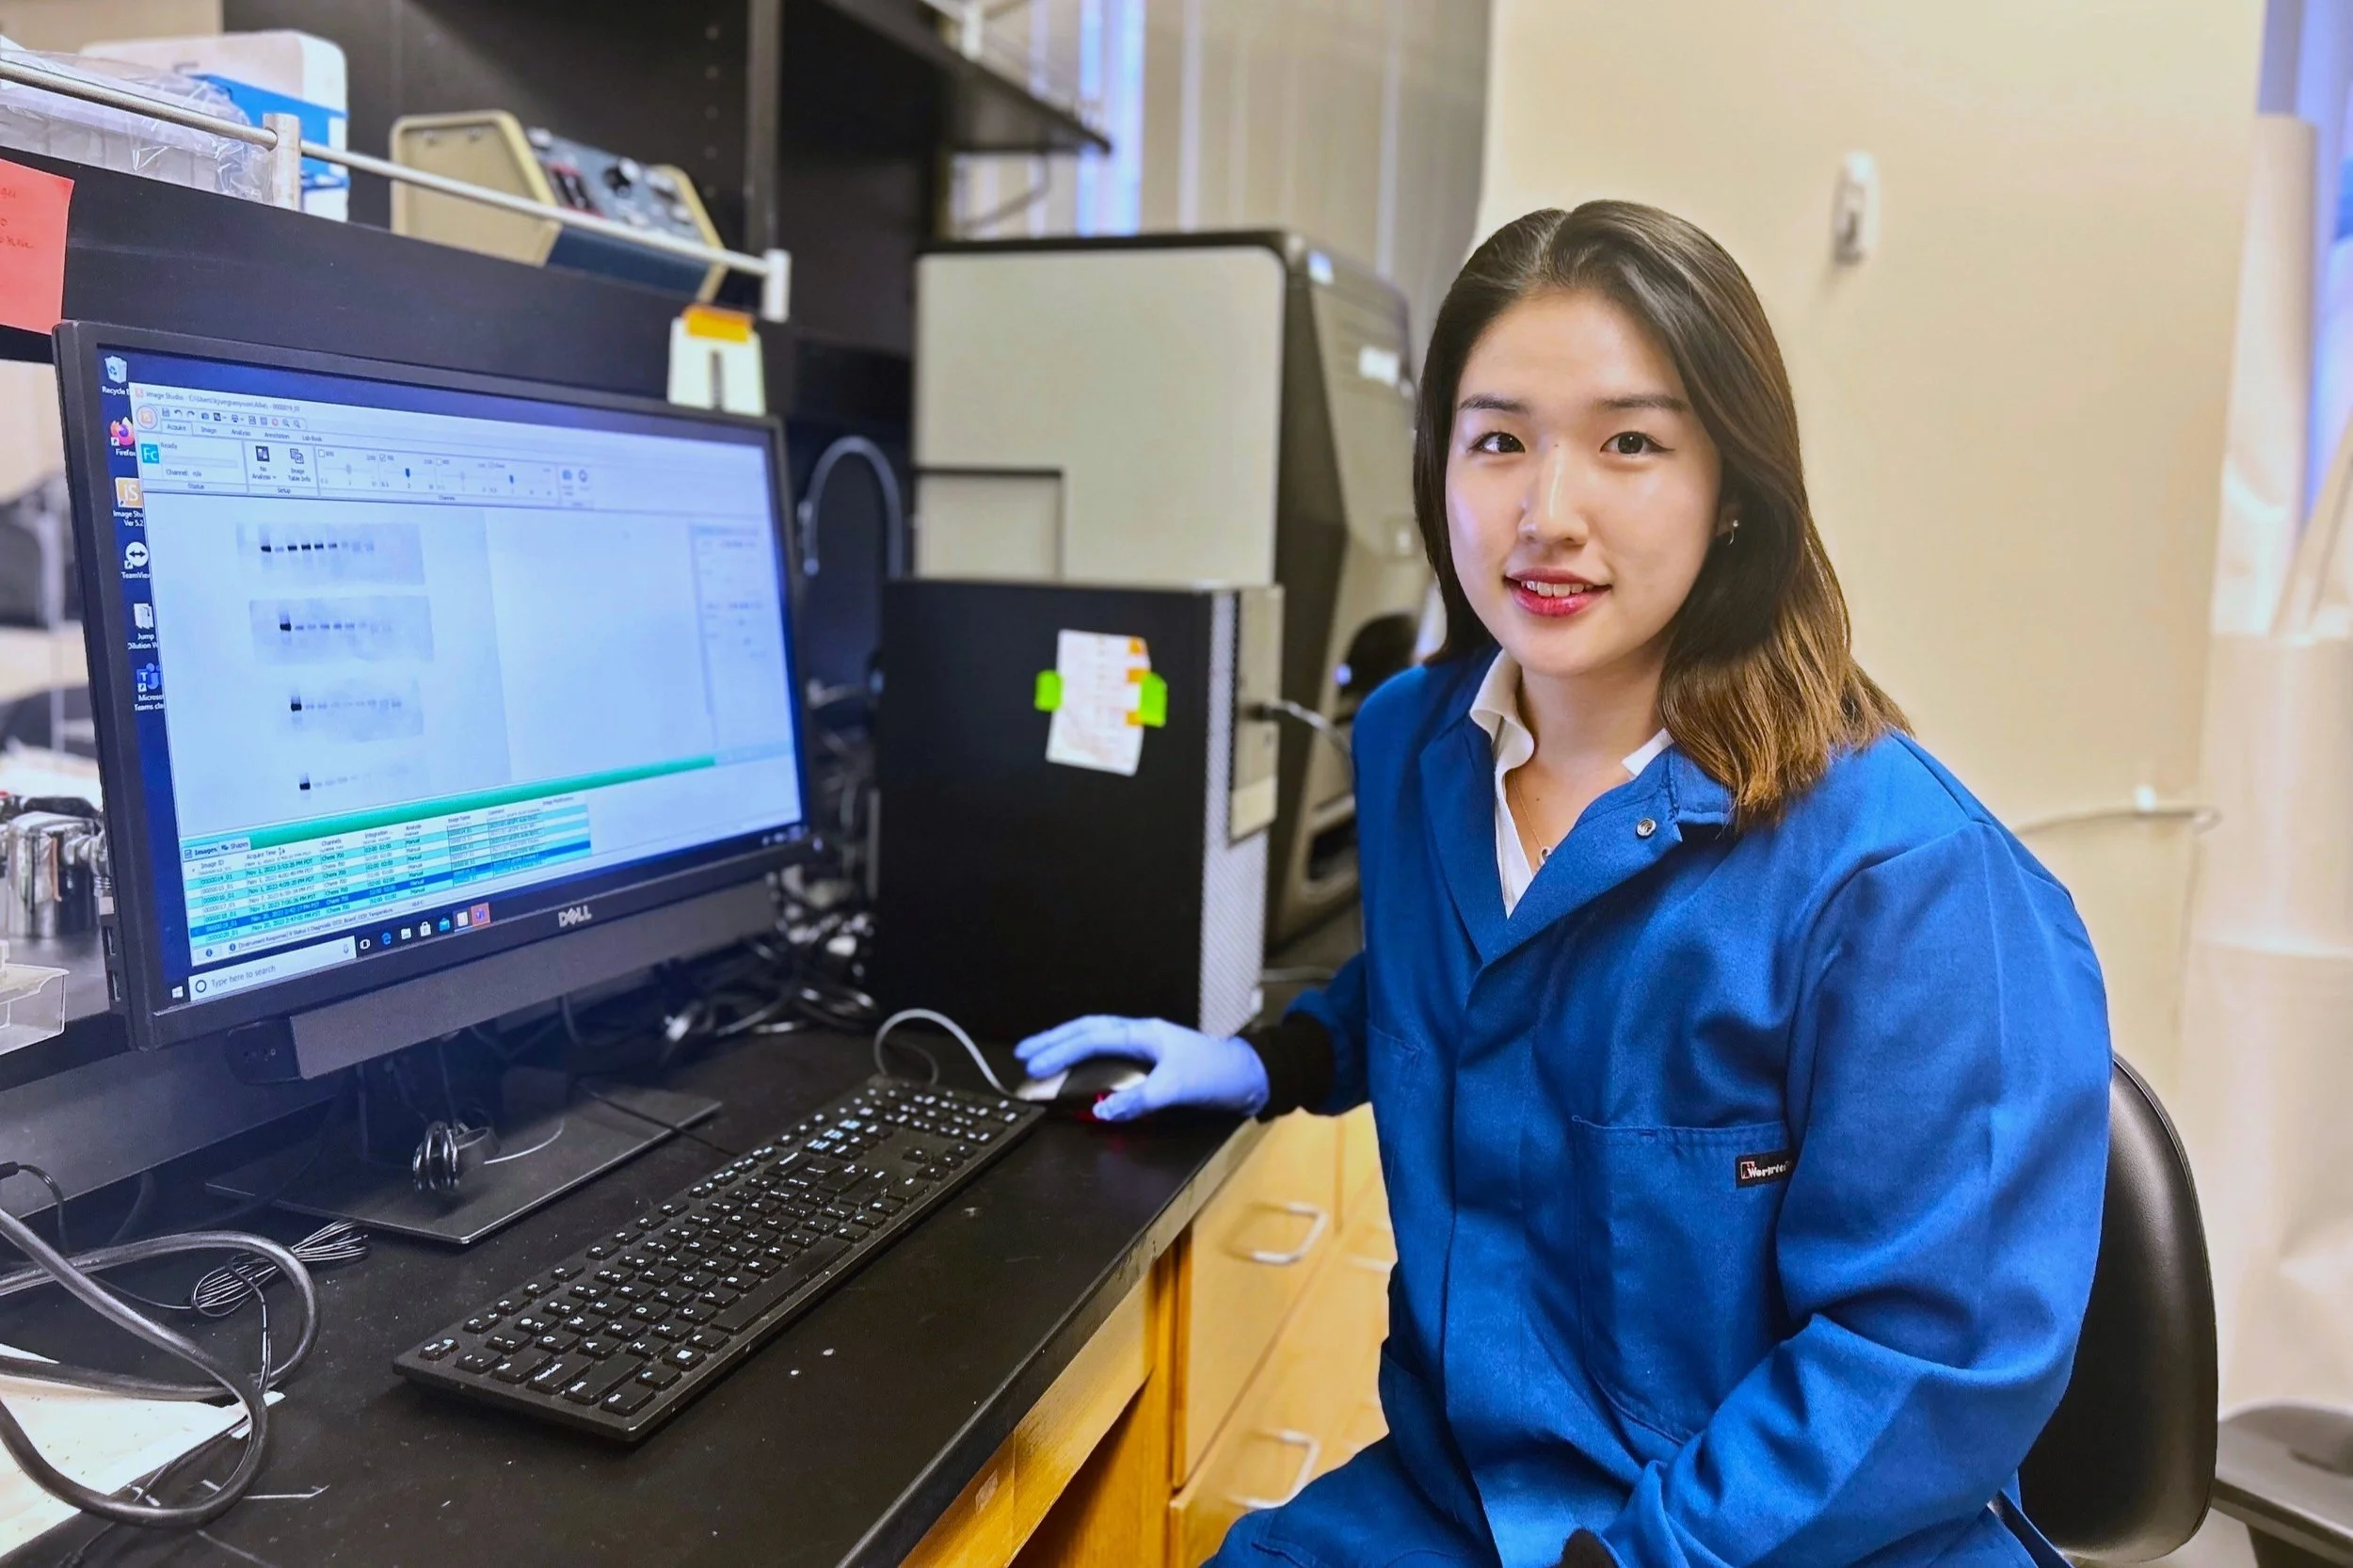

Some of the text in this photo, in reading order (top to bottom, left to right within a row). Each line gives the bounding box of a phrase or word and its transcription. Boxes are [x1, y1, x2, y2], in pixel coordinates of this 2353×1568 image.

[102, 386, 125, 395] Recycle
[143, 446, 158, 461] Fc
[113, 509, 132, 519] Image
[123, 519, 135, 527] Ver
[137, 632, 155, 641] Jump
[134, 703, 154, 712] Teams
[194, 846, 217, 856] Images
[200, 860, 216, 869] Image
[558, 904, 592, 928] DELL
[210, 977, 228, 989] Type
[229, 974, 245, 985] here
[254, 965, 276, 978] search
